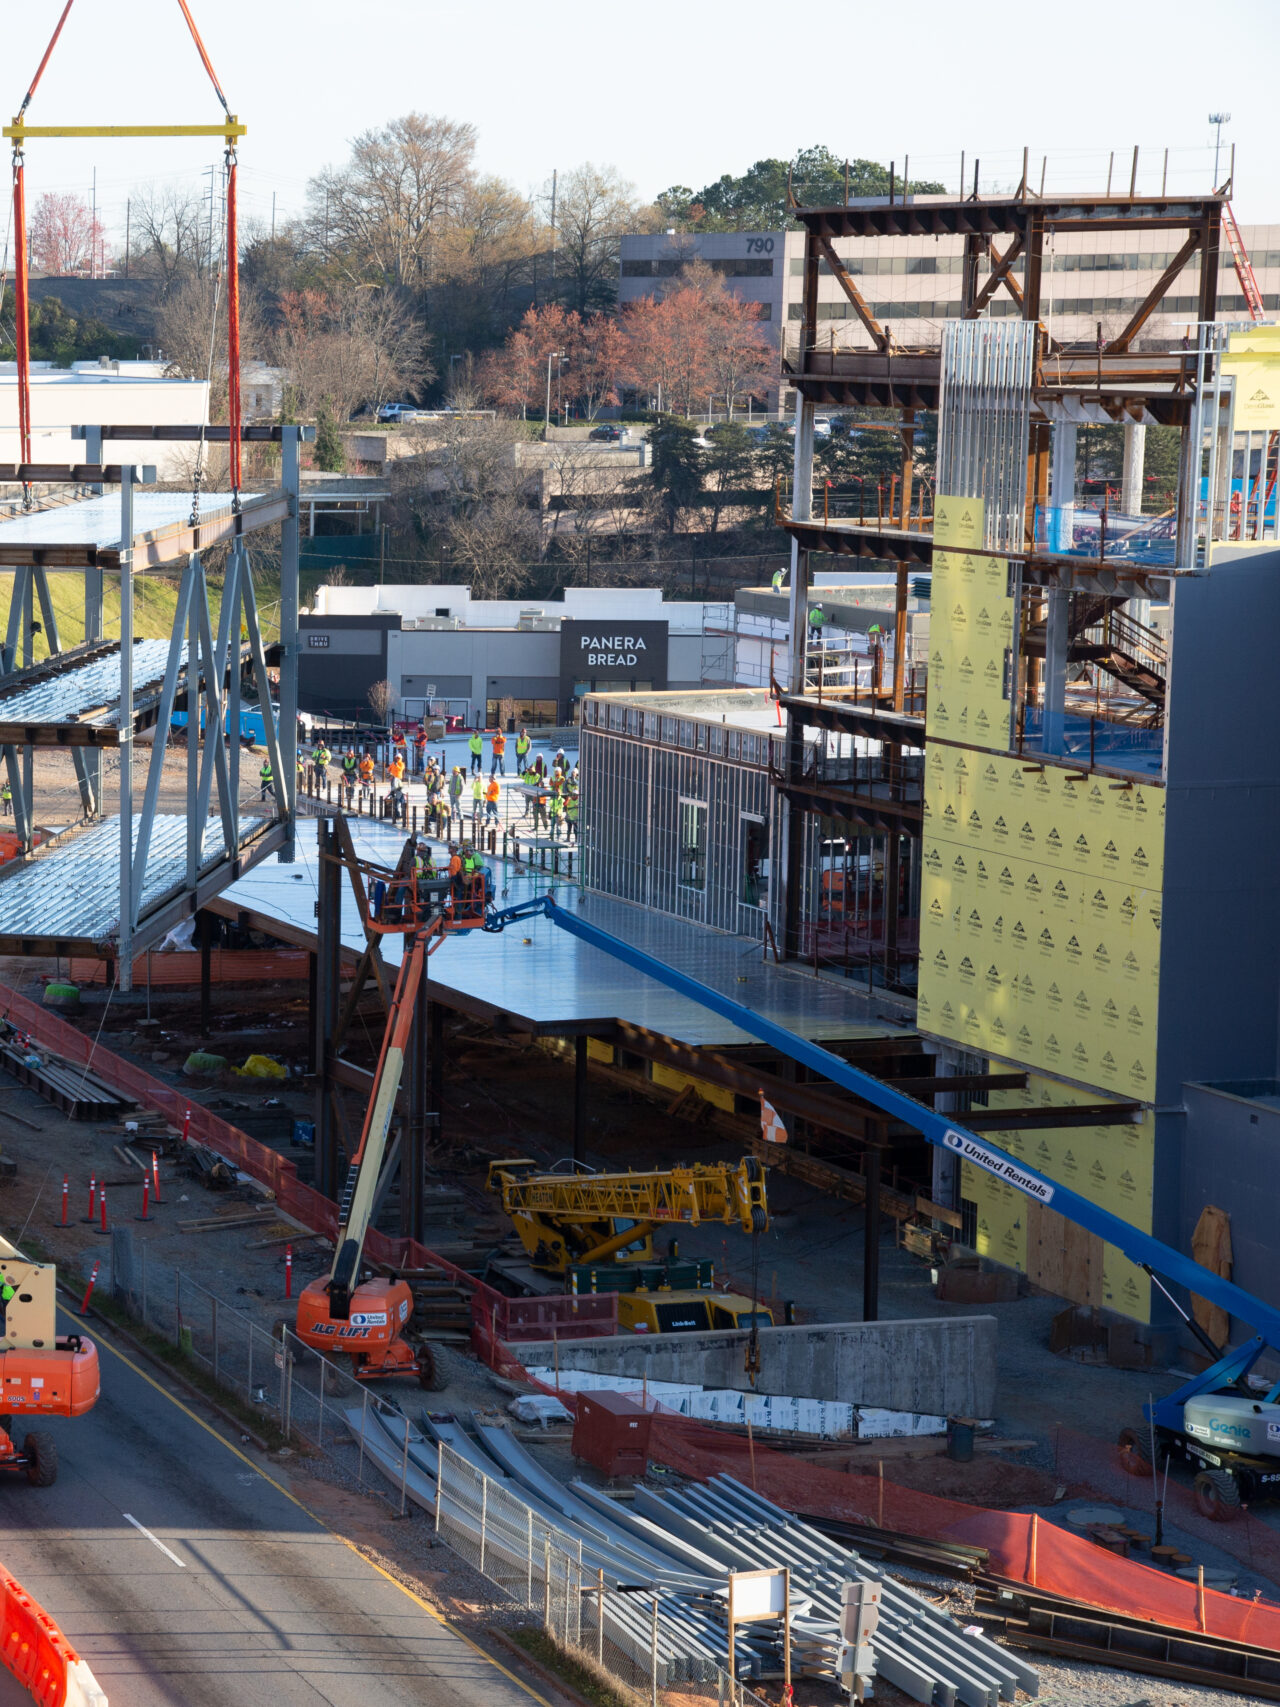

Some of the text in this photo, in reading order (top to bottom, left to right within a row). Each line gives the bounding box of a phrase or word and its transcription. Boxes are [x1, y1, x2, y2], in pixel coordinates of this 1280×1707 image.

[746, 237, 774, 254] 790
[581, 636, 647, 650] PANERA
[588, 653, 638, 666] BREAD
[964, 1143, 1047, 1197] United Rentals
[312, 1324, 372, 1338] JLG LIFT
[1209, 1418, 1251, 1438] Genie
